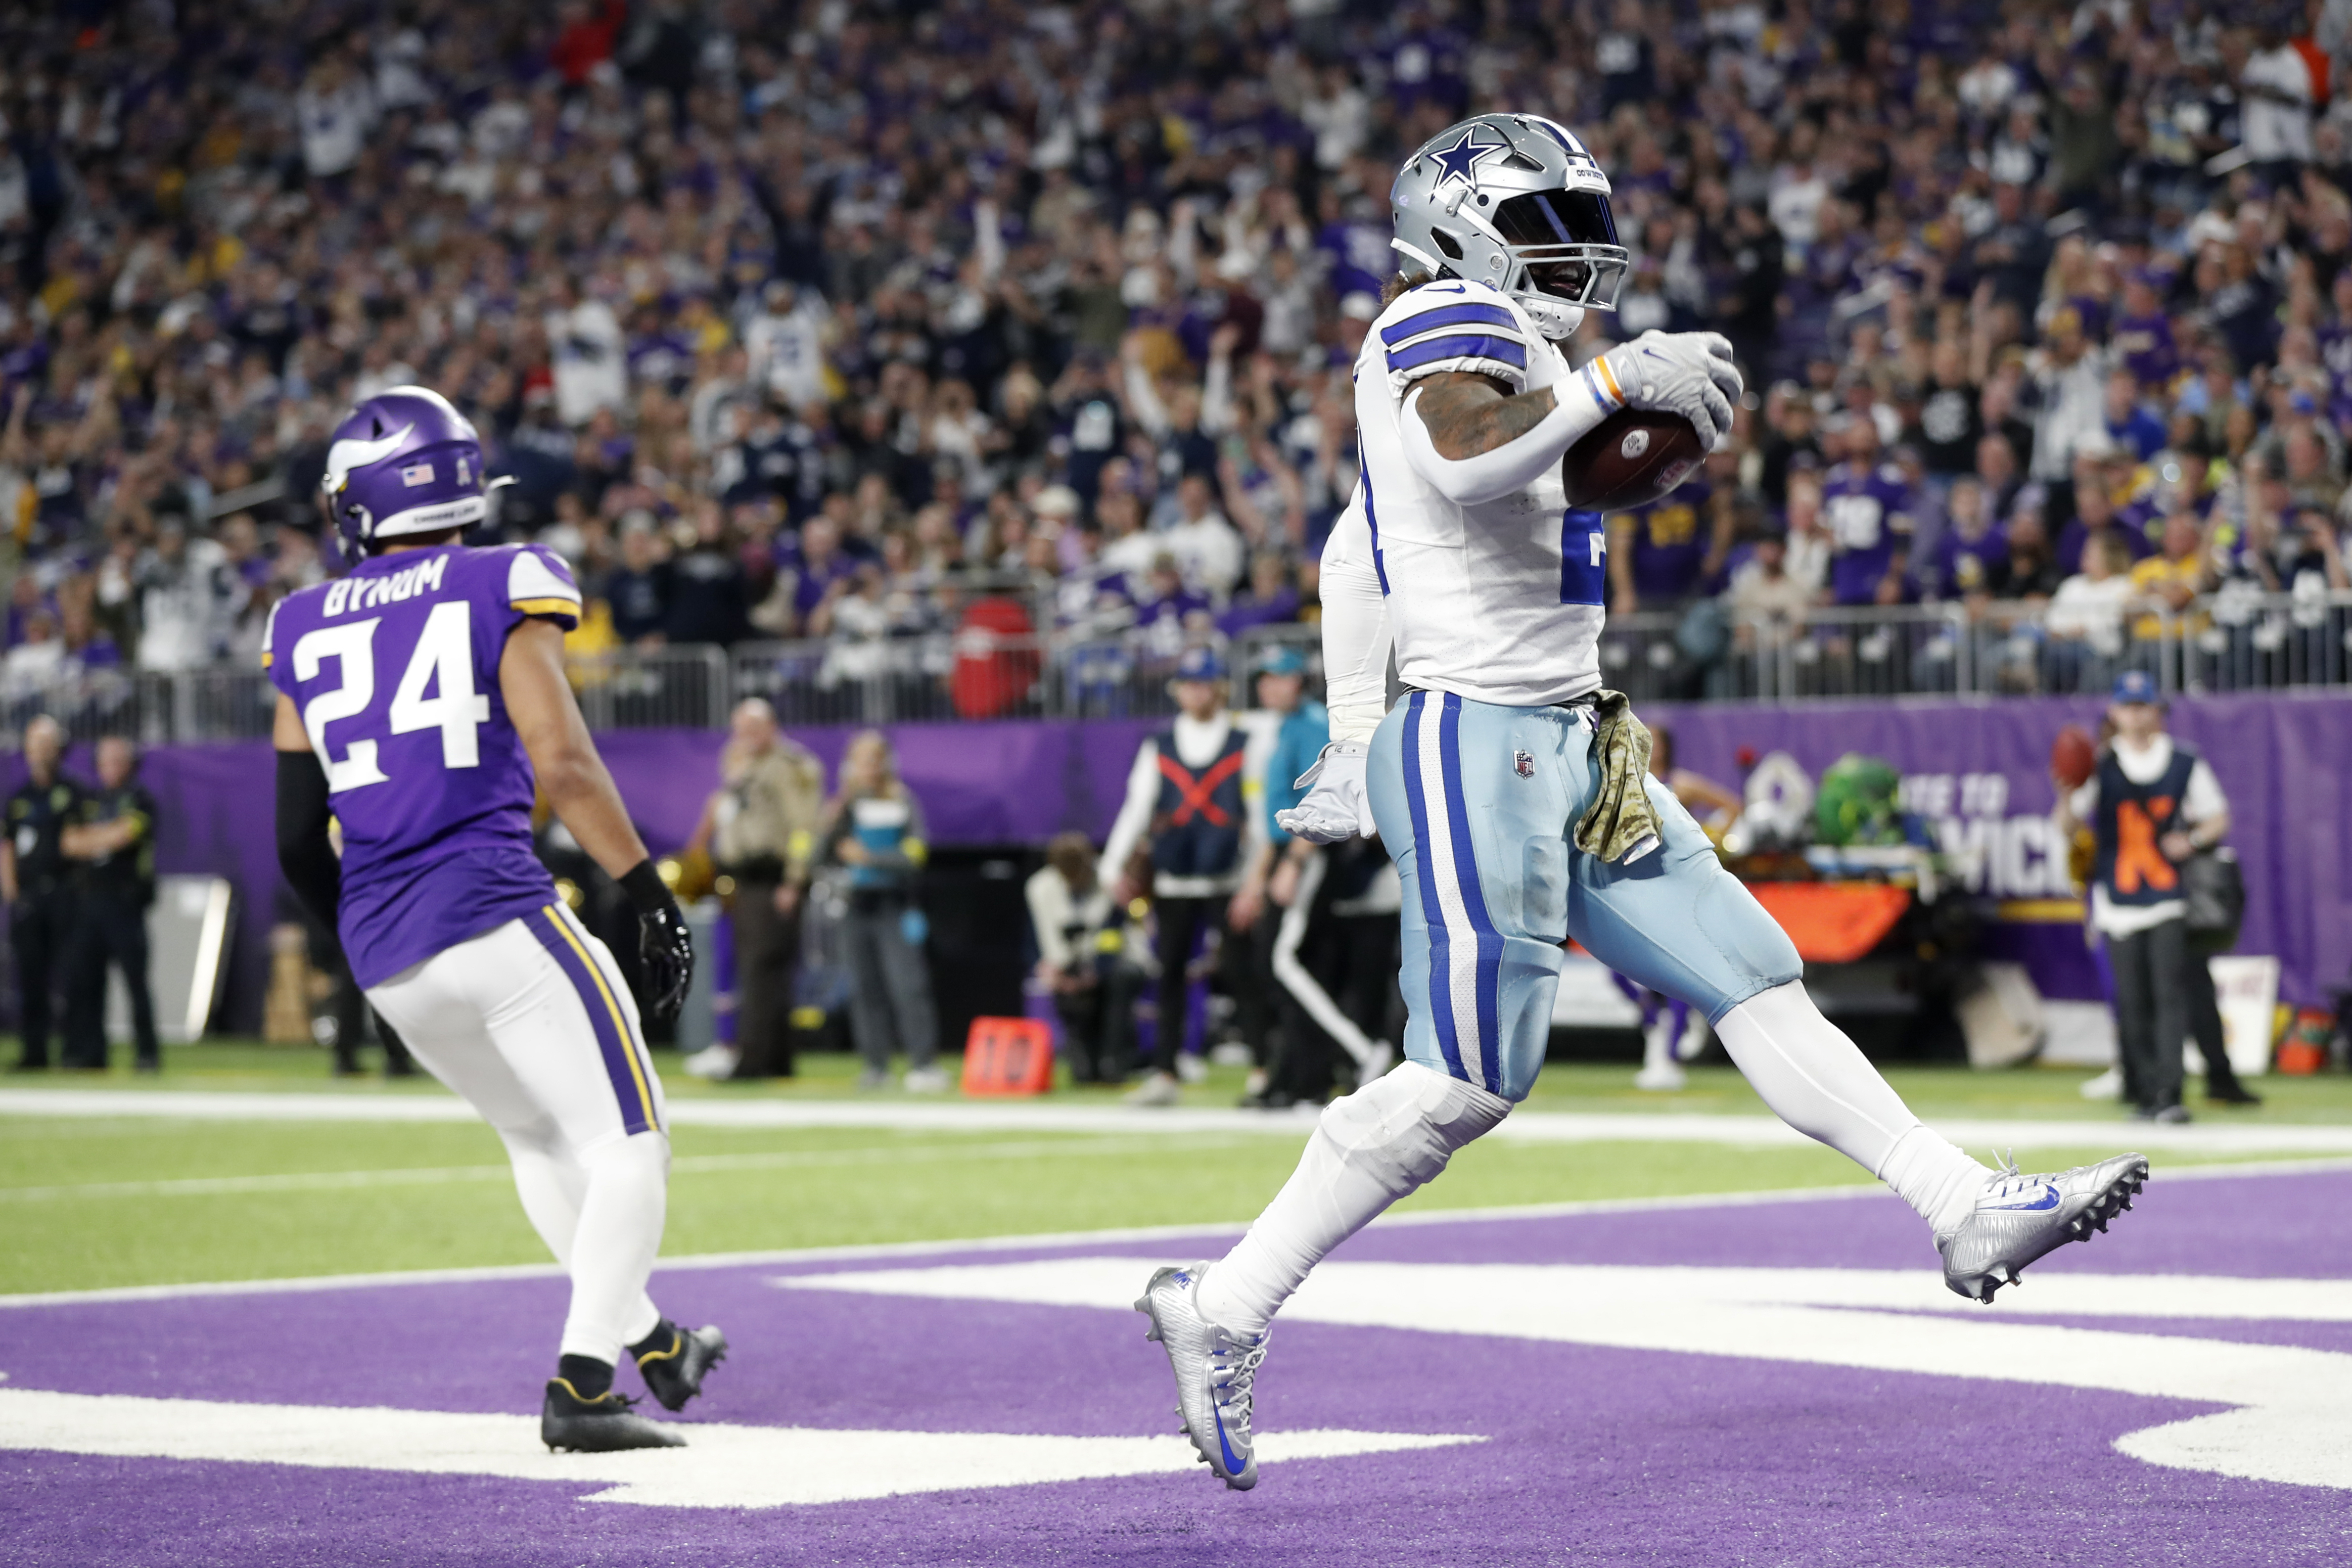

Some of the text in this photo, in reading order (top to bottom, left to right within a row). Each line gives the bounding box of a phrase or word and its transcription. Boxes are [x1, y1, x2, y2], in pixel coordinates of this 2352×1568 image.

[322, 554, 450, 618] BYNUM
[292, 600, 491, 794] 24
[1518, 761, 1532, 773] NFL
